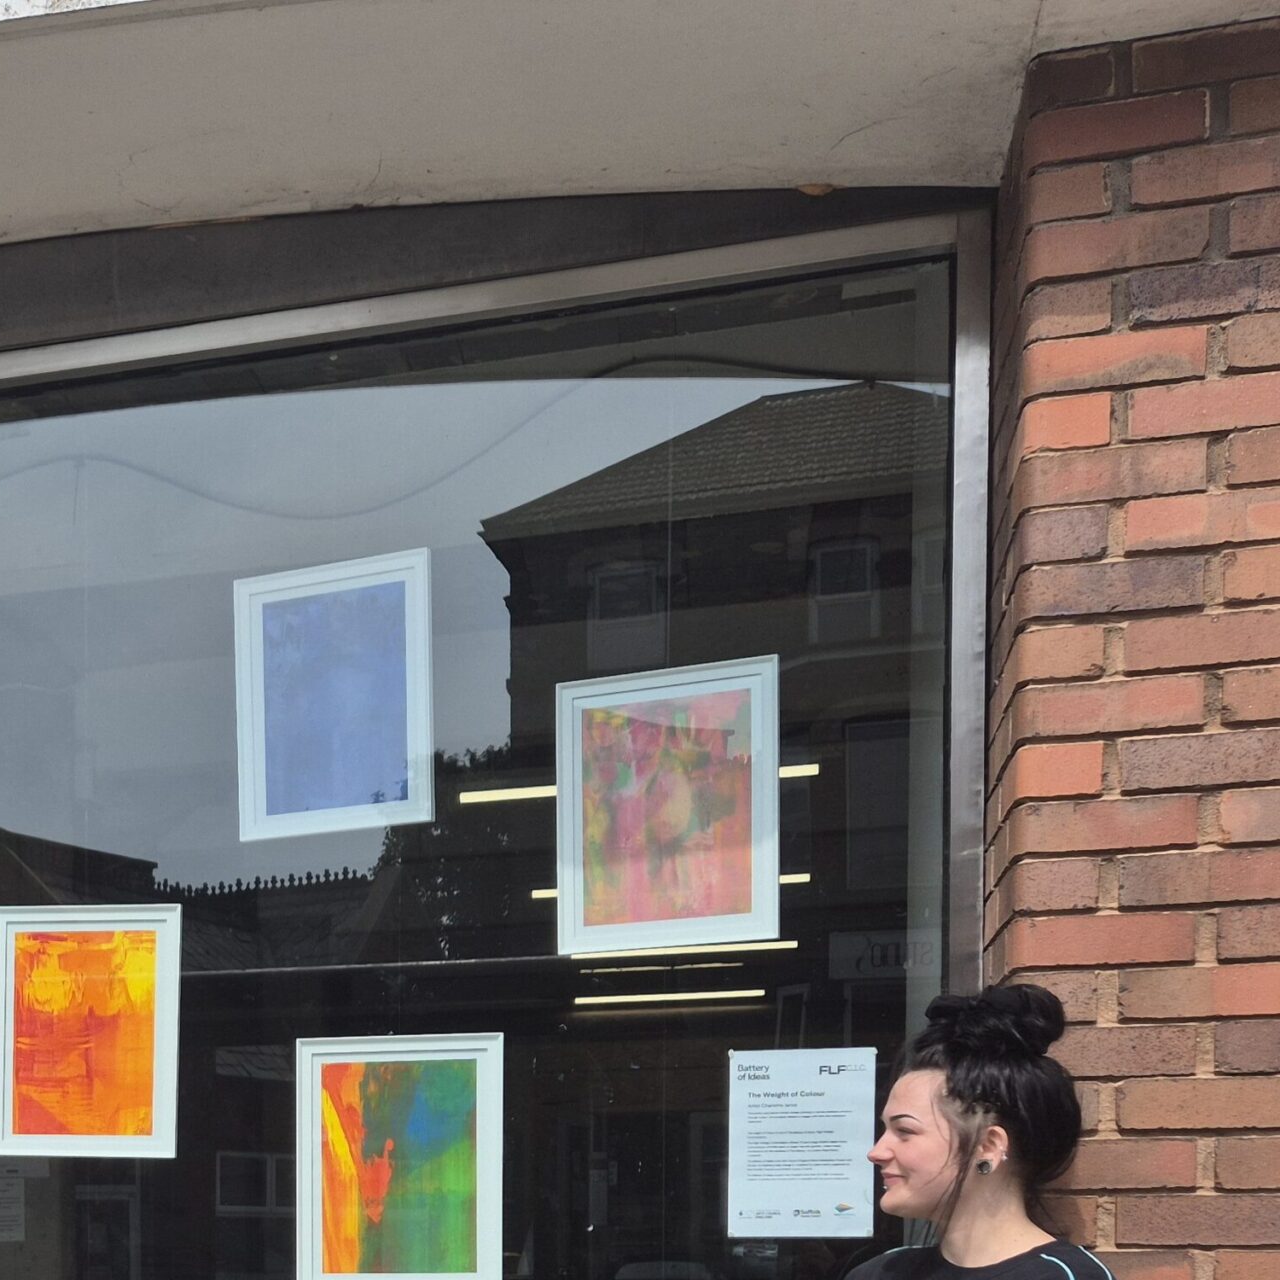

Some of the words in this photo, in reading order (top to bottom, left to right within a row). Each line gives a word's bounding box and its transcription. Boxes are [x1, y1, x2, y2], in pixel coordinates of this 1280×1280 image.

[737, 1064, 770, 1073] Battery
[819, 1065, 846, 1075] FLF
[737, 1073, 746, 1081] of
[748, 1073, 770, 1081] Ideas
[763, 1091, 789, 1099] Weight
